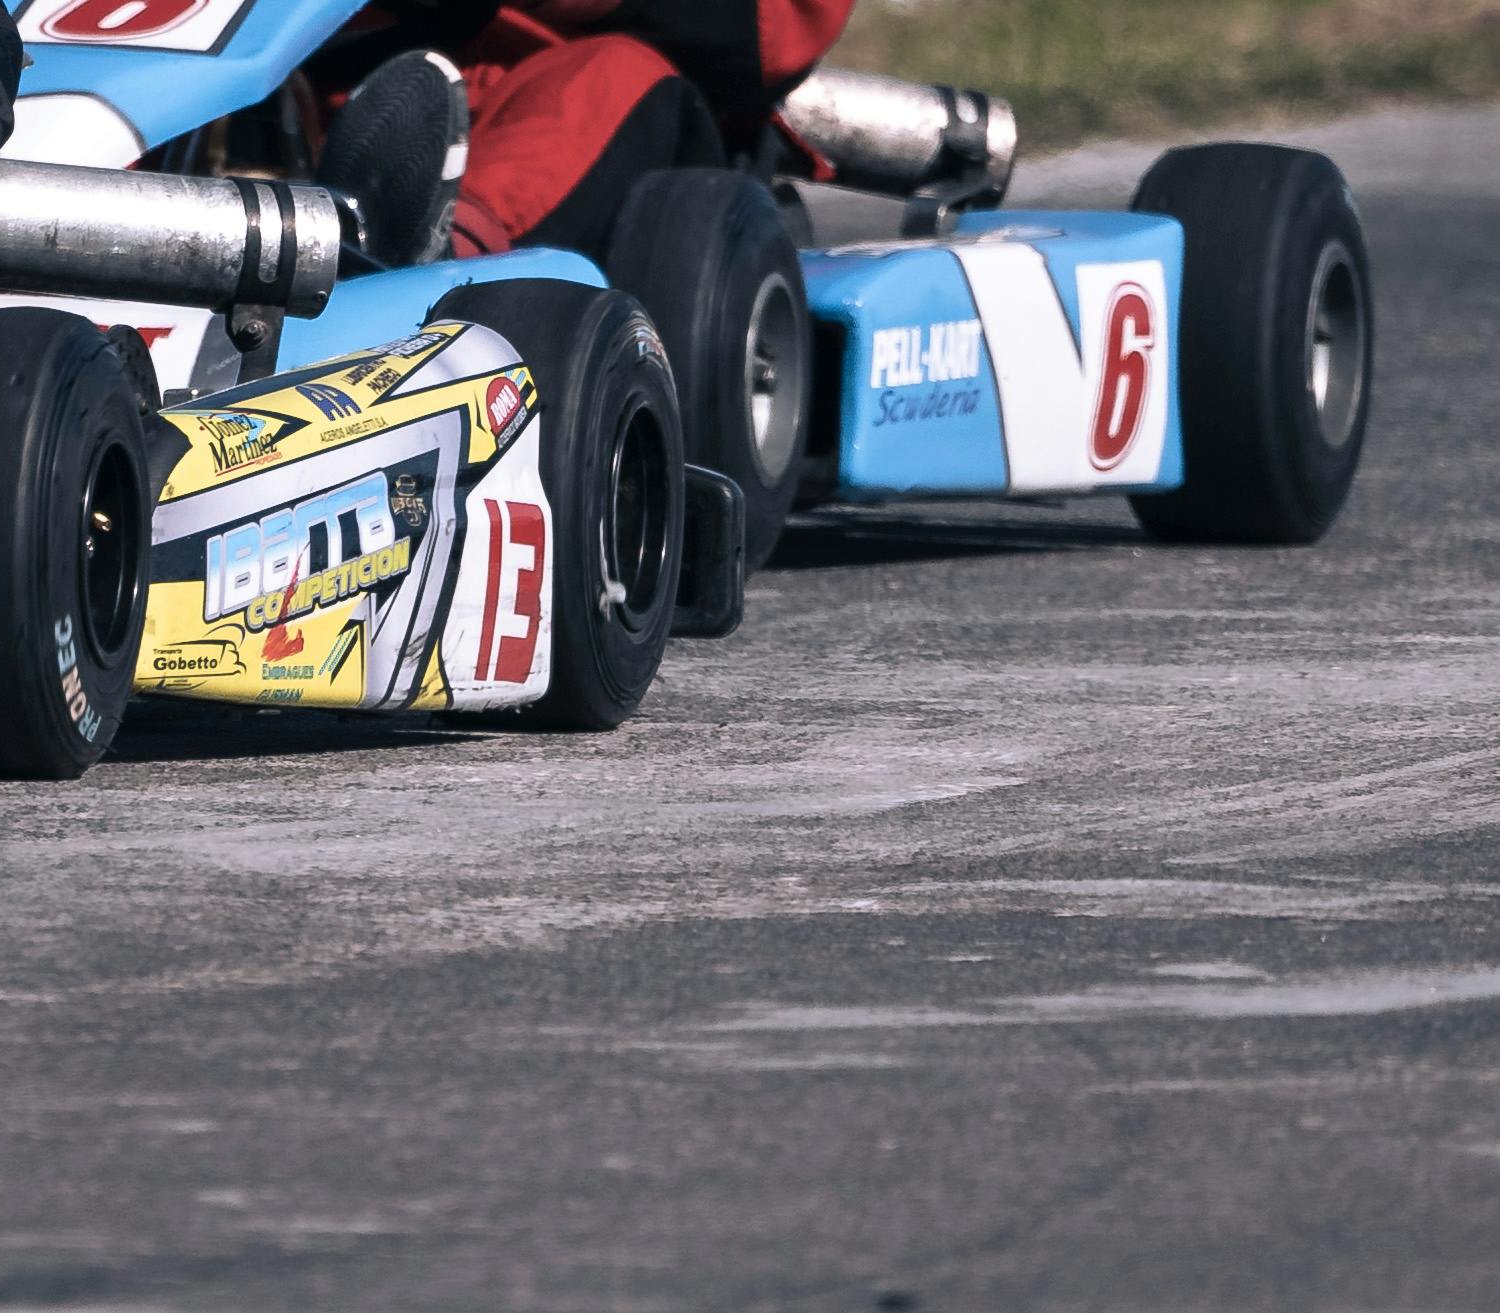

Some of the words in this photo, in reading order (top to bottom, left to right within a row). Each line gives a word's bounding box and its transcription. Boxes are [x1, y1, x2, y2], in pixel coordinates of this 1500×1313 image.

[870, 318, 981, 389] PELL-KART
[1088, 281, 1155, 472] 6
[246, 534, 411, 629] COMPETICION
[475, 497, 546, 684] 13
[153, 657, 218, 671] Gobetto
